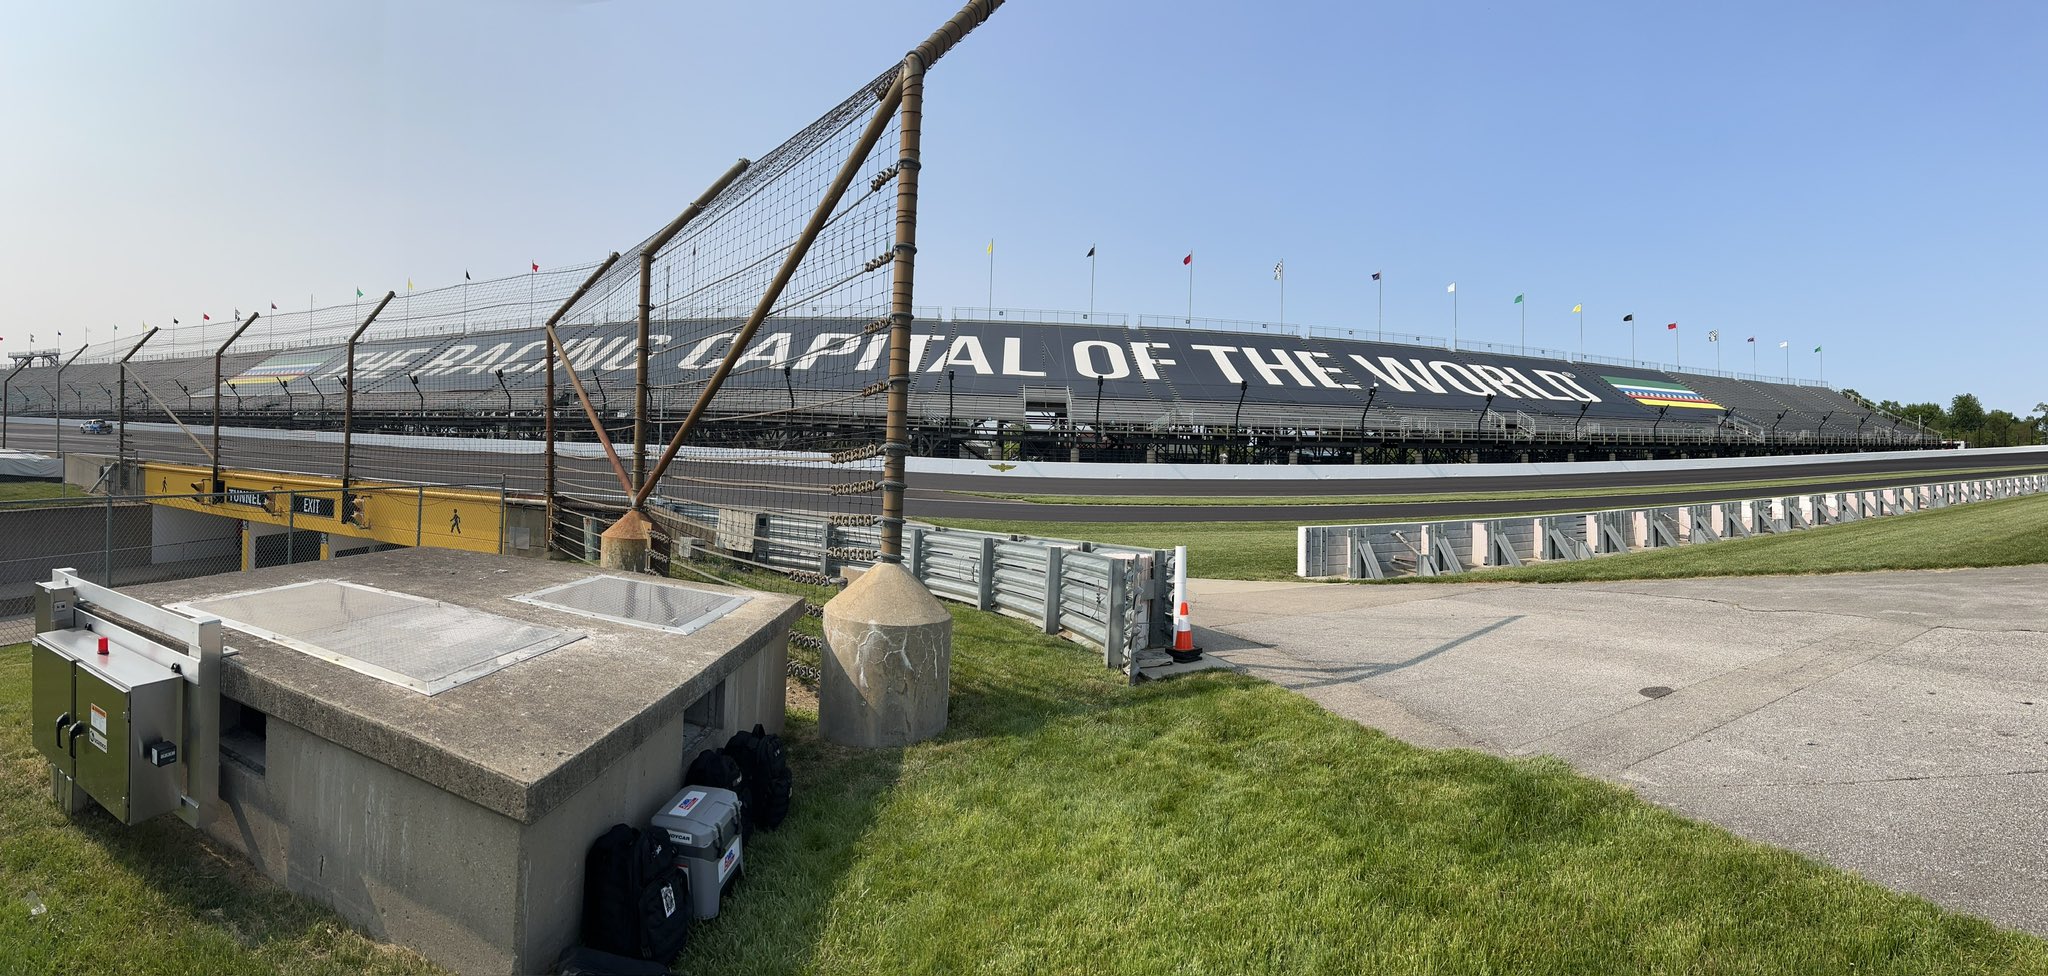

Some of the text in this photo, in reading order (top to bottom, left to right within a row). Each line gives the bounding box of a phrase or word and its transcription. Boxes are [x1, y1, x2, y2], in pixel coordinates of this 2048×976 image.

[312, 348, 432, 382] THE
[406, 333, 672, 377] RACING
[677, 332, 1047, 377] CAPITAL
[1072, 340, 1176, 380] OF
[1191, 344, 1362, 390] THE
[228, 488, 262, 506] TUNNEL
[303, 498, 320, 514] EXIT
